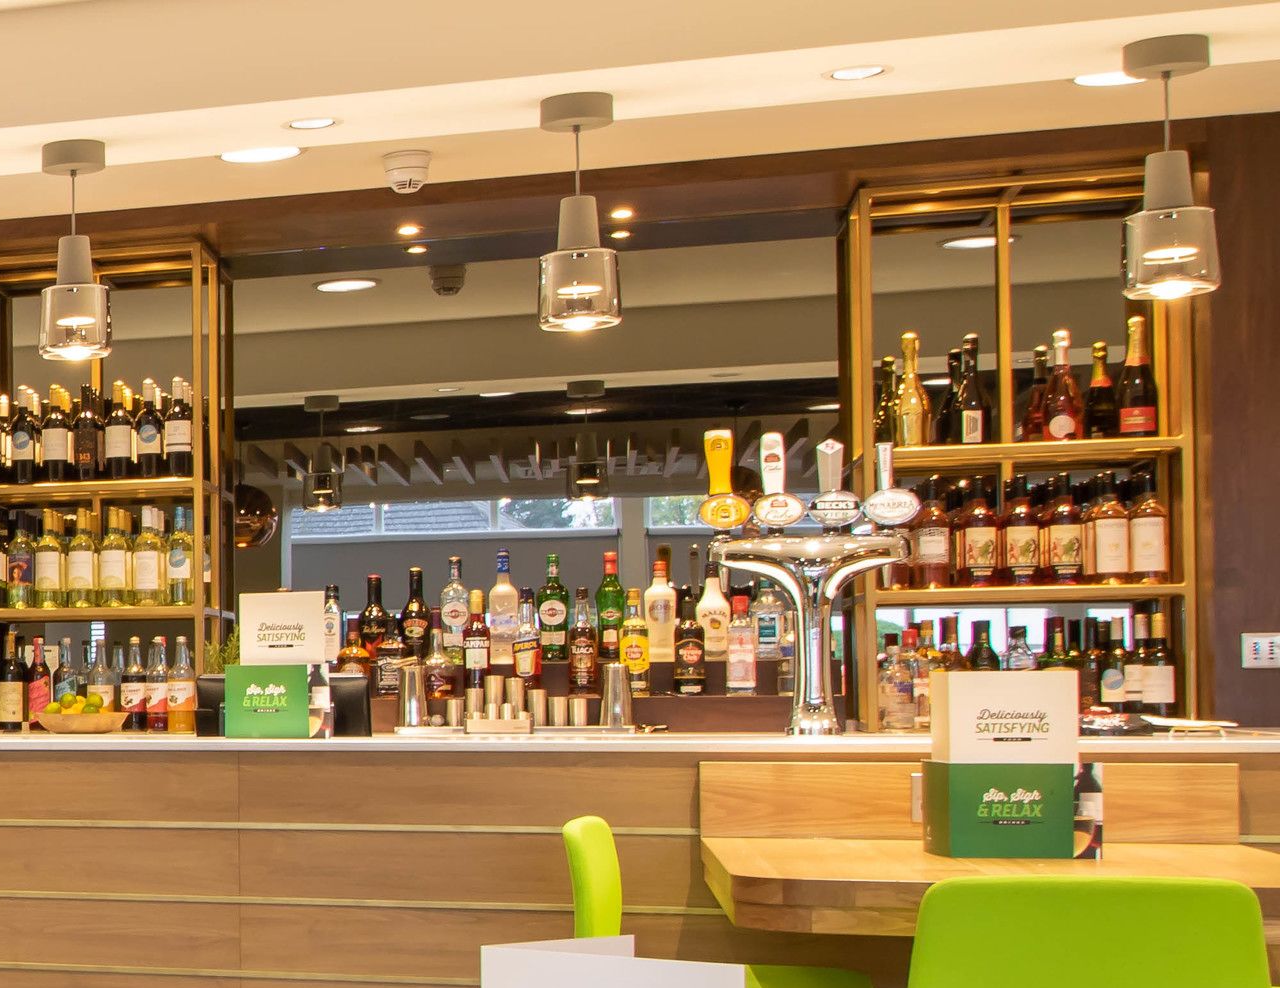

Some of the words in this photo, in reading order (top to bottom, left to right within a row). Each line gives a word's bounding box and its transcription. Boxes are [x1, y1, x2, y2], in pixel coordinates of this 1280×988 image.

[256, 632, 306, 642] SATISFYING
[252, 696, 287, 706] RELAX
[977, 709, 1047, 723] Deliciously
[975, 722, 1050, 734] SATISFYING
[991, 803, 1043, 817] RELAX
